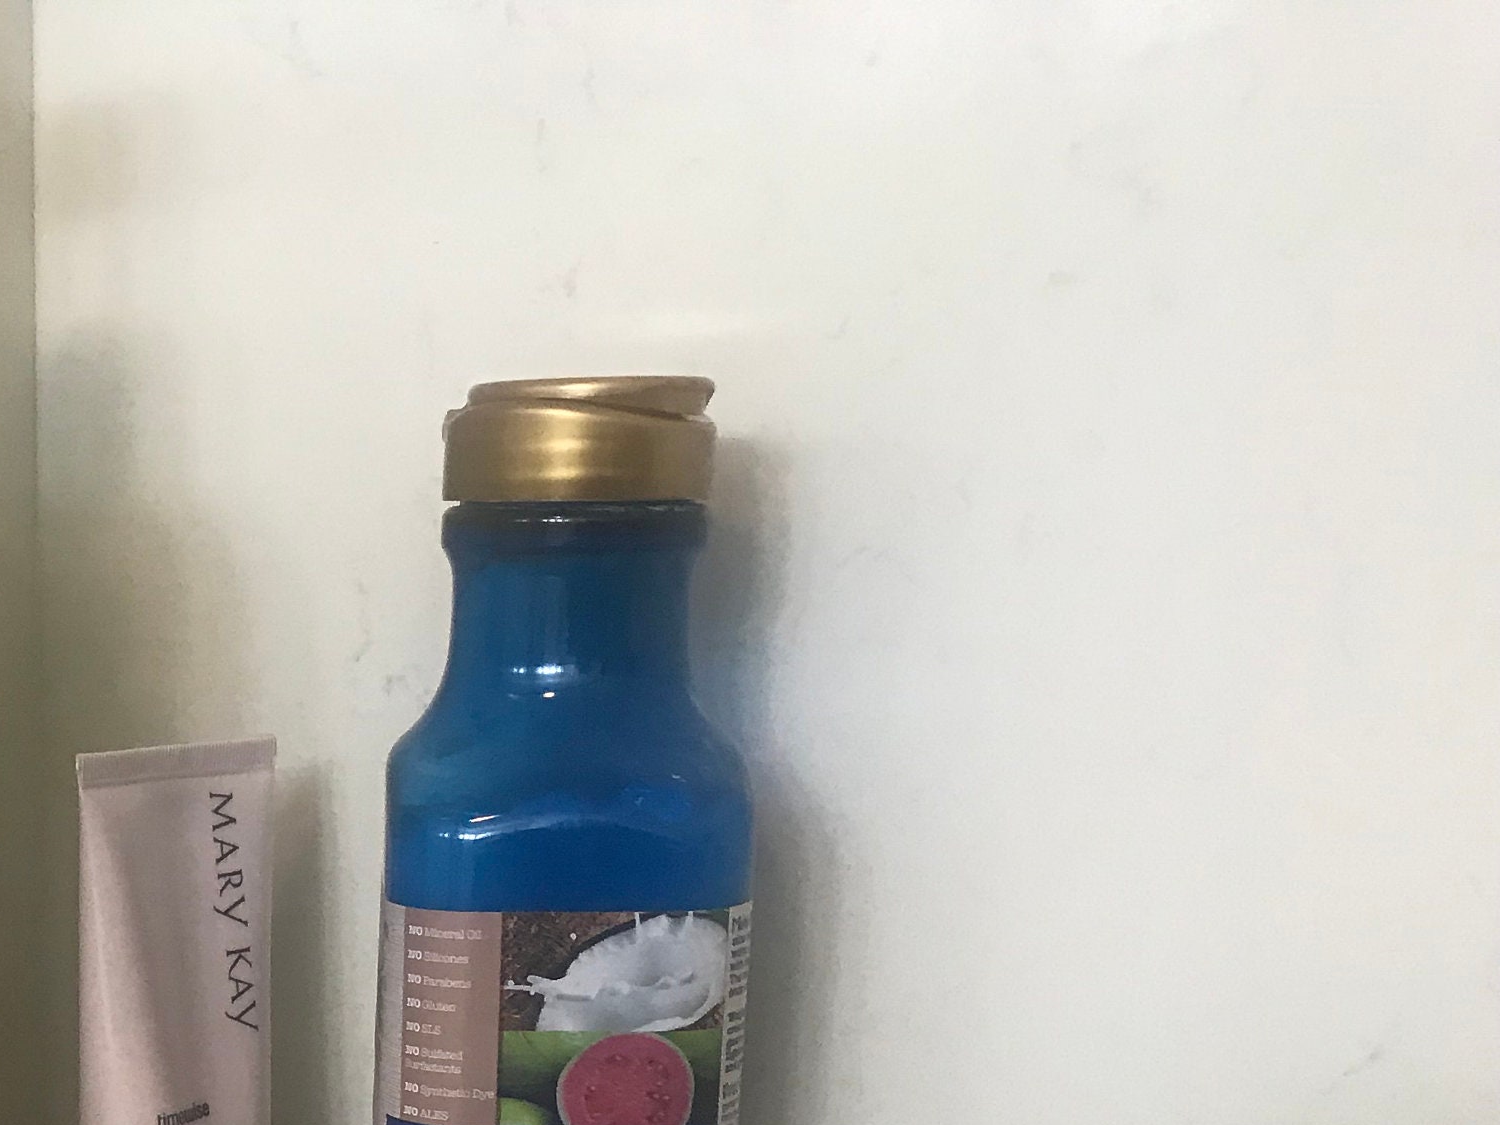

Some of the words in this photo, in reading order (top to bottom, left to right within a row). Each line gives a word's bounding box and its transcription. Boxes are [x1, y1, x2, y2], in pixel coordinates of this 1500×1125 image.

[209, 791, 249, 927] MARY
[409, 925, 423, 936] NO
[408, 950, 422, 960] NO
[407, 973, 422, 984] NO
[225, 946, 259, 1032] KAY
[406, 998, 421, 1008] NO
[406, 1021, 420, 1032] NO
[421, 1023, 442, 1035] SLS
[405, 1045, 420, 1056] NO
[404, 1081, 419, 1093] NO
[403, 1105, 418, 1116] NO
